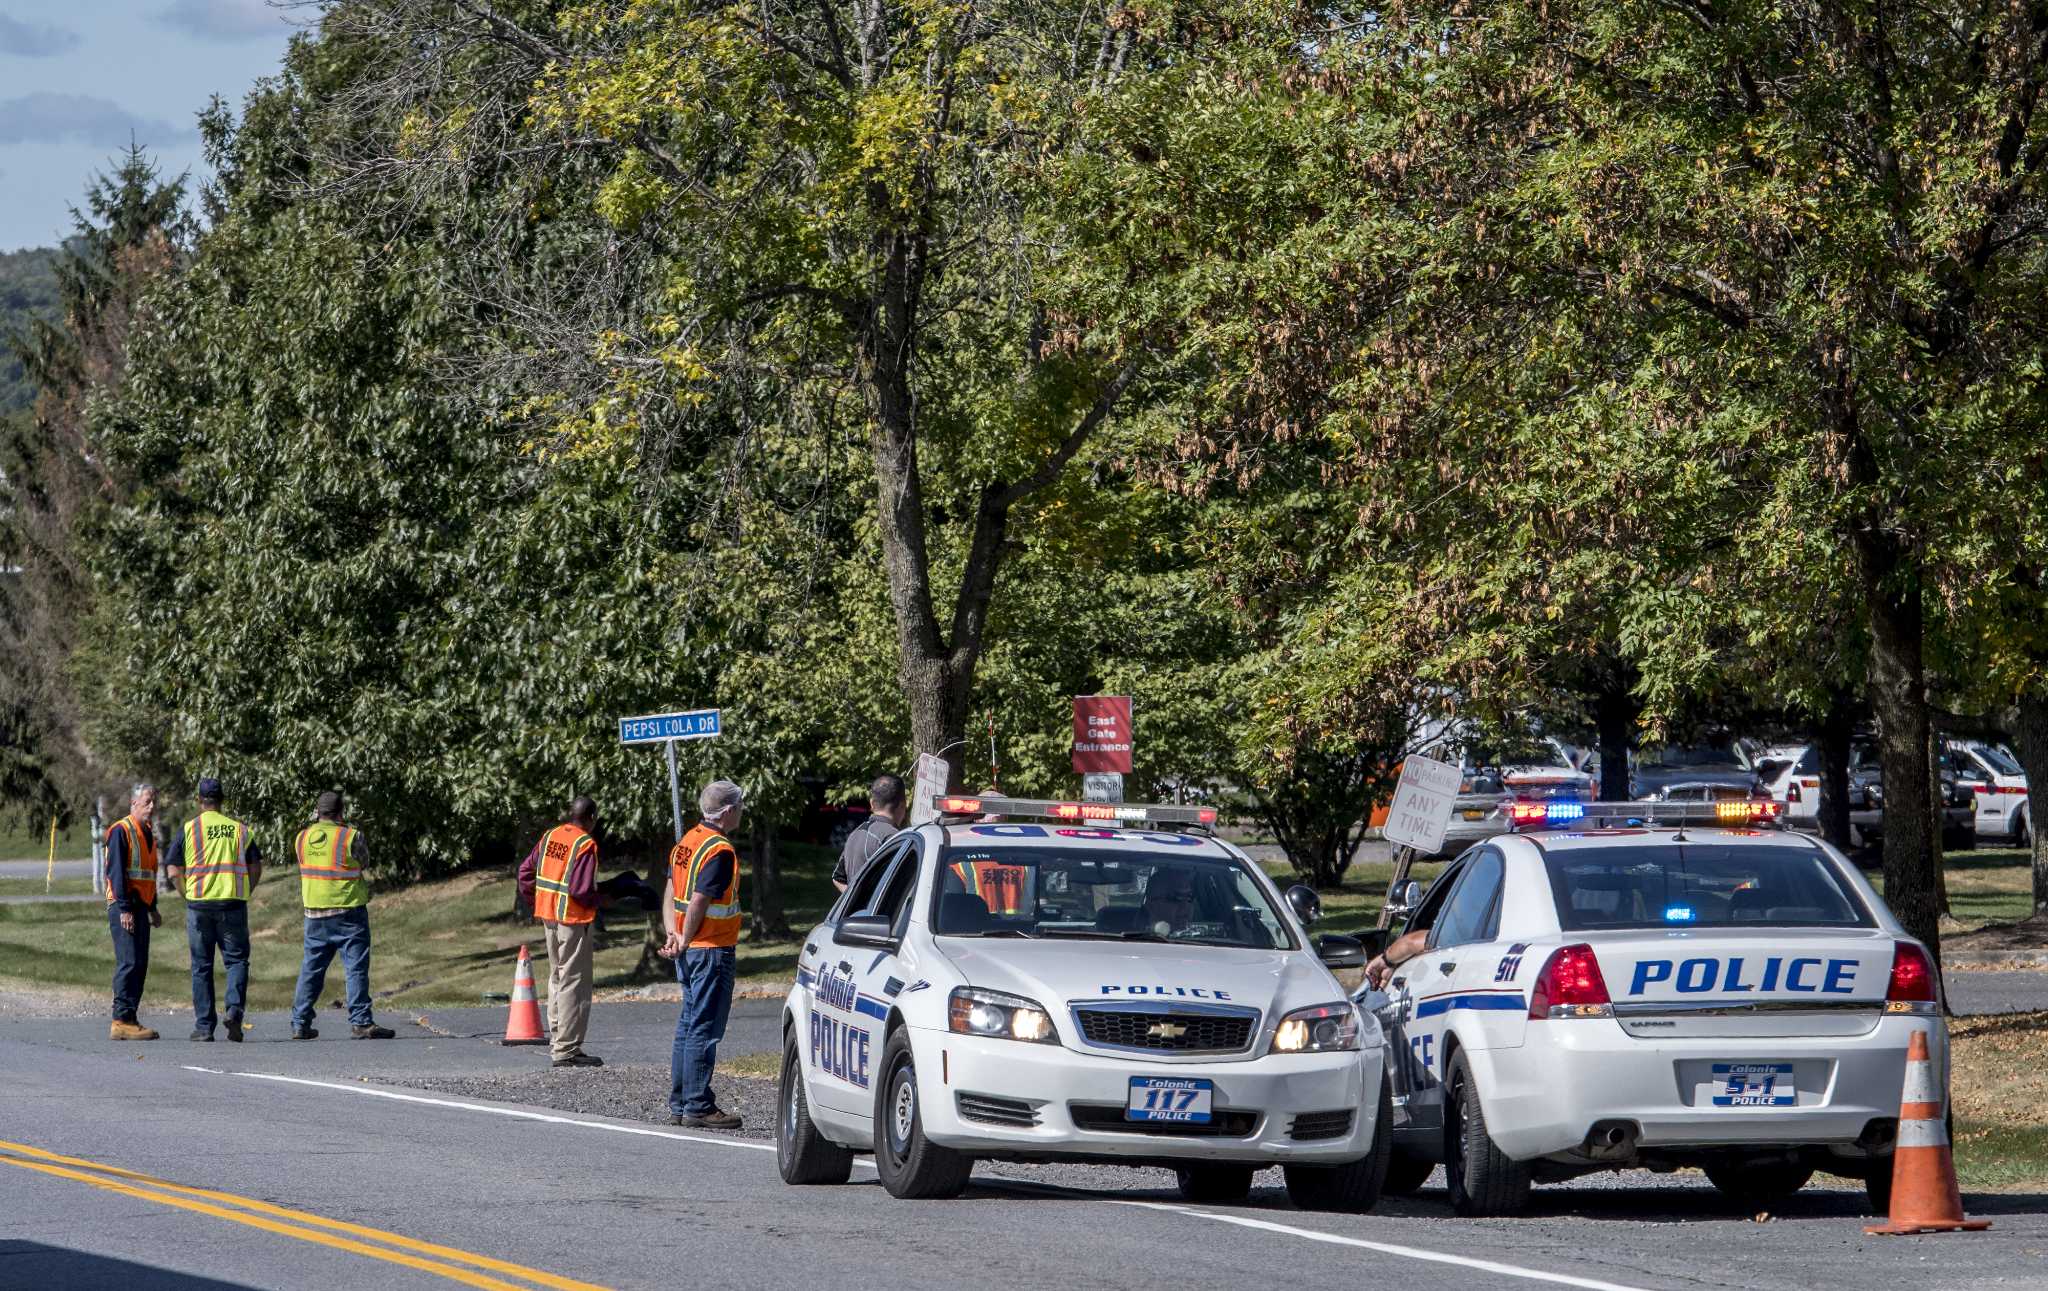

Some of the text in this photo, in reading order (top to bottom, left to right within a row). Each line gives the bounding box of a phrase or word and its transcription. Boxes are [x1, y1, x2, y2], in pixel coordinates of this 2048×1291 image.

[624, 716, 715, 737] PEPSI COLA DR
[1088, 716, 1116, 726] East
[1087, 728, 1117, 739] Gate
[1075, 742, 1130, 752] Entrance
[1087, 781, 1118, 790] VISITOR
[1406, 793, 1440, 814] ANY
[207, 825, 236, 833] ZERO
[1400, 813, 1436, 838] TIME
[207, 831, 235, 840] ZONE
[548, 840, 569, 853] ZERO
[545, 847, 566, 861] ZONE
[1628, 957, 1860, 996] POLICE
[815, 961, 857, 1014] Colonie
[1101, 985, 1232, 1000] POLICE
[810, 1008, 870, 1090] POLICE
[1729, 1064, 1777, 1073] Colonie
[1148, 1079, 1196, 1089] Colonie
[1726, 1074, 1777, 1096] 5-1
[1144, 1089, 1200, 1111] 117
[1731, 1097, 1777, 1105] POLICE
[1148, 1111, 1192, 1121] POLICE
